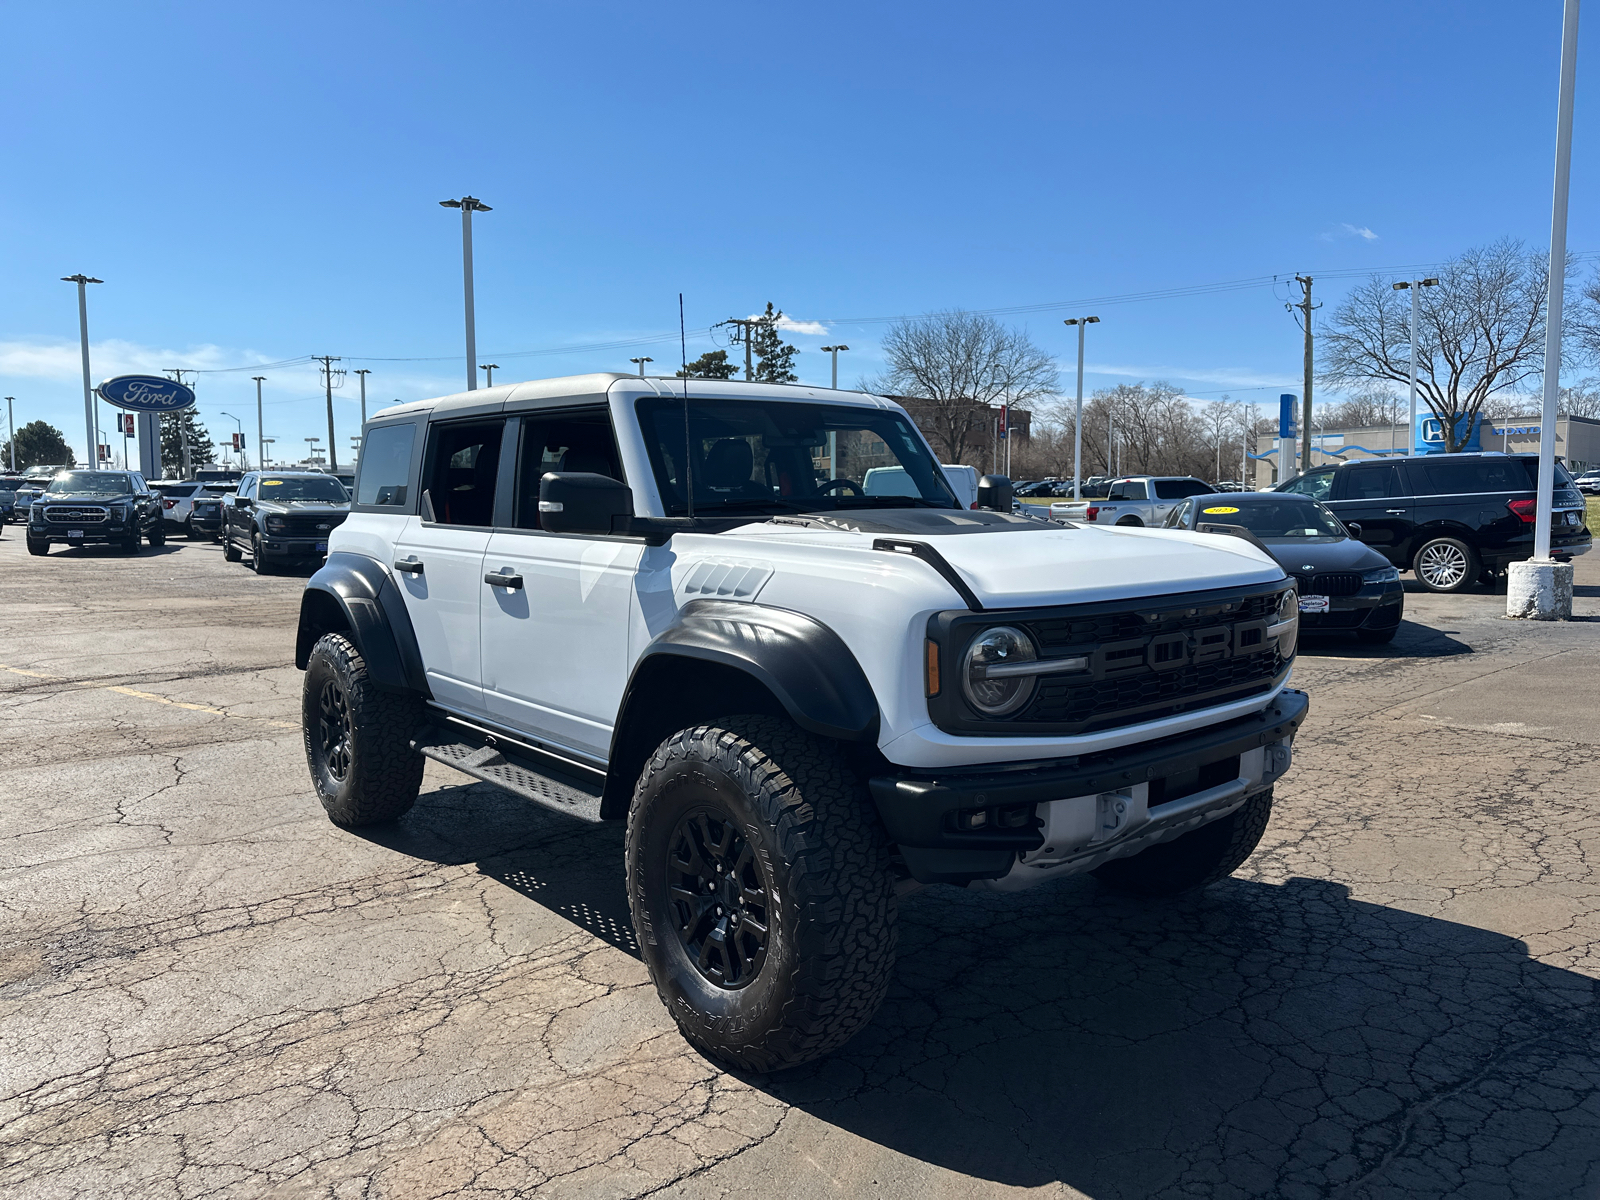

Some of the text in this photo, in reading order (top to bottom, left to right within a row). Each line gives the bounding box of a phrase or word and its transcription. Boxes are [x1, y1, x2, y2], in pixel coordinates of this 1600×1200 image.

[121, 381, 178, 405] Ford
[1492, 426, 1541, 436] HOND
[1094, 618, 1268, 682] FORD
